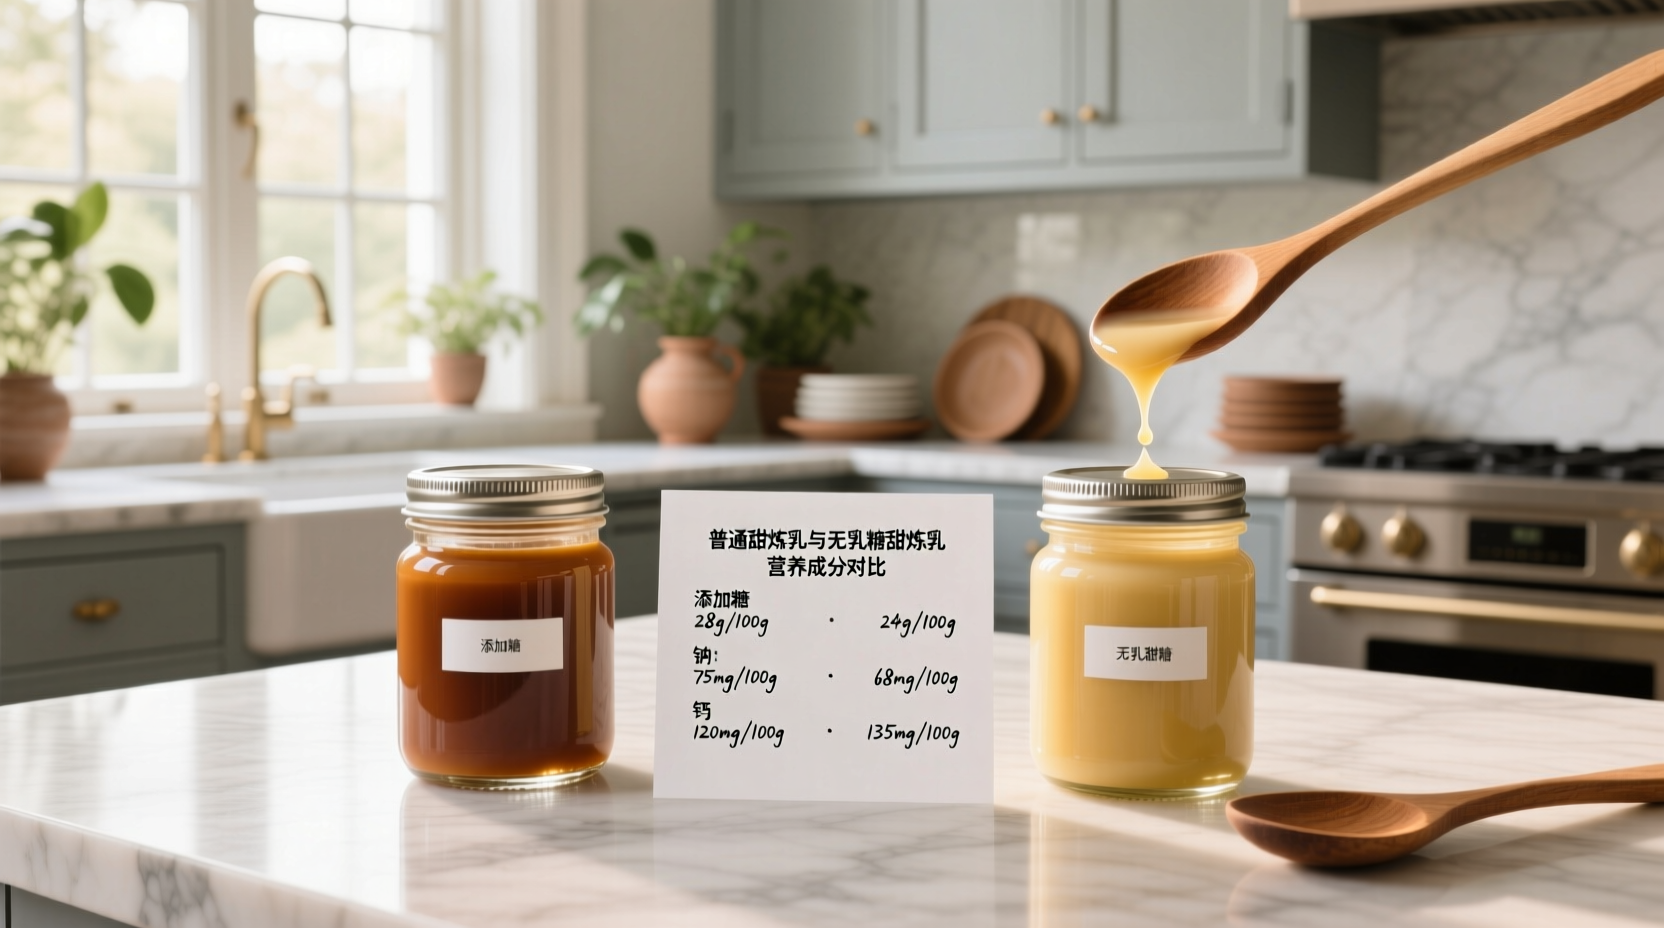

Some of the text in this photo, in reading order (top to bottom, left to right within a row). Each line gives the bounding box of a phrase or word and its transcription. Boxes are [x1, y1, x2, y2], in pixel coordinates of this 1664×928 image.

[766, 555, 886, 578] 营养成分对比
[693, 589, 750, 609] 添加糖
[693, 610, 956, 639] 28g/100g 24g/100g
[693, 666, 959, 695] 75mg/100g 68mg/100g
[692, 700, 711, 721] 钙
[693, 720, 960, 750] 120mg/100g 135mg/100g
